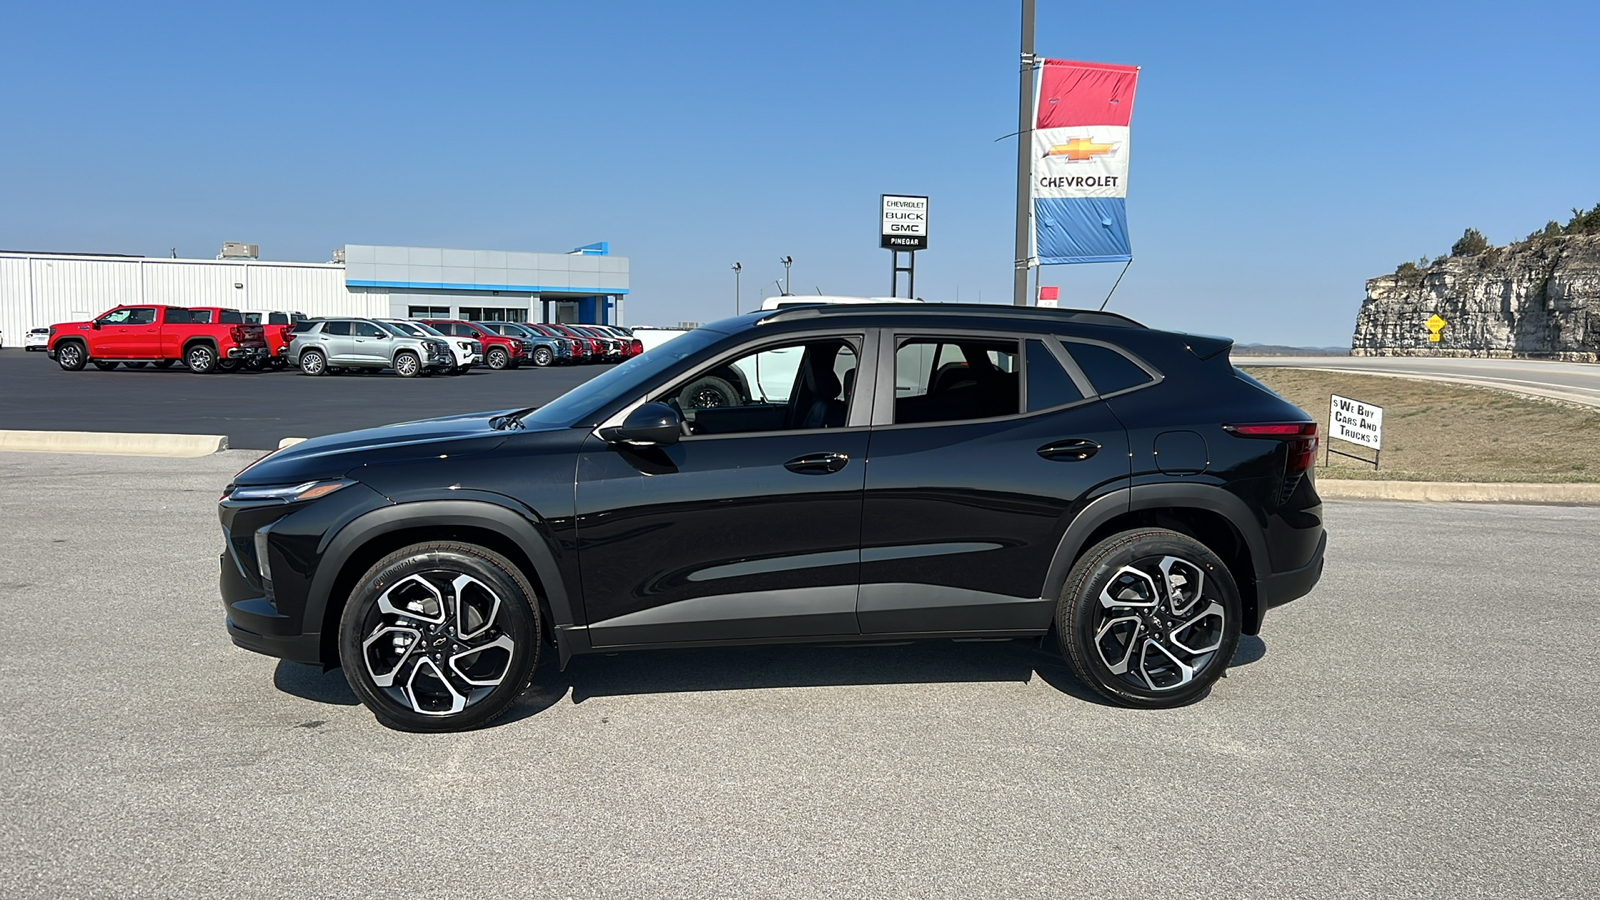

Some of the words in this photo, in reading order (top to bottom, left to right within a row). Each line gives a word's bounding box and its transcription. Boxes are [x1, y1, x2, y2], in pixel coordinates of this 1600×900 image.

[1040, 176, 1118, 188] CHEVROLET
[886, 200, 924, 208] CHEVROLET
[885, 211, 924, 220] BUICK
[891, 224, 919, 232] GMC
